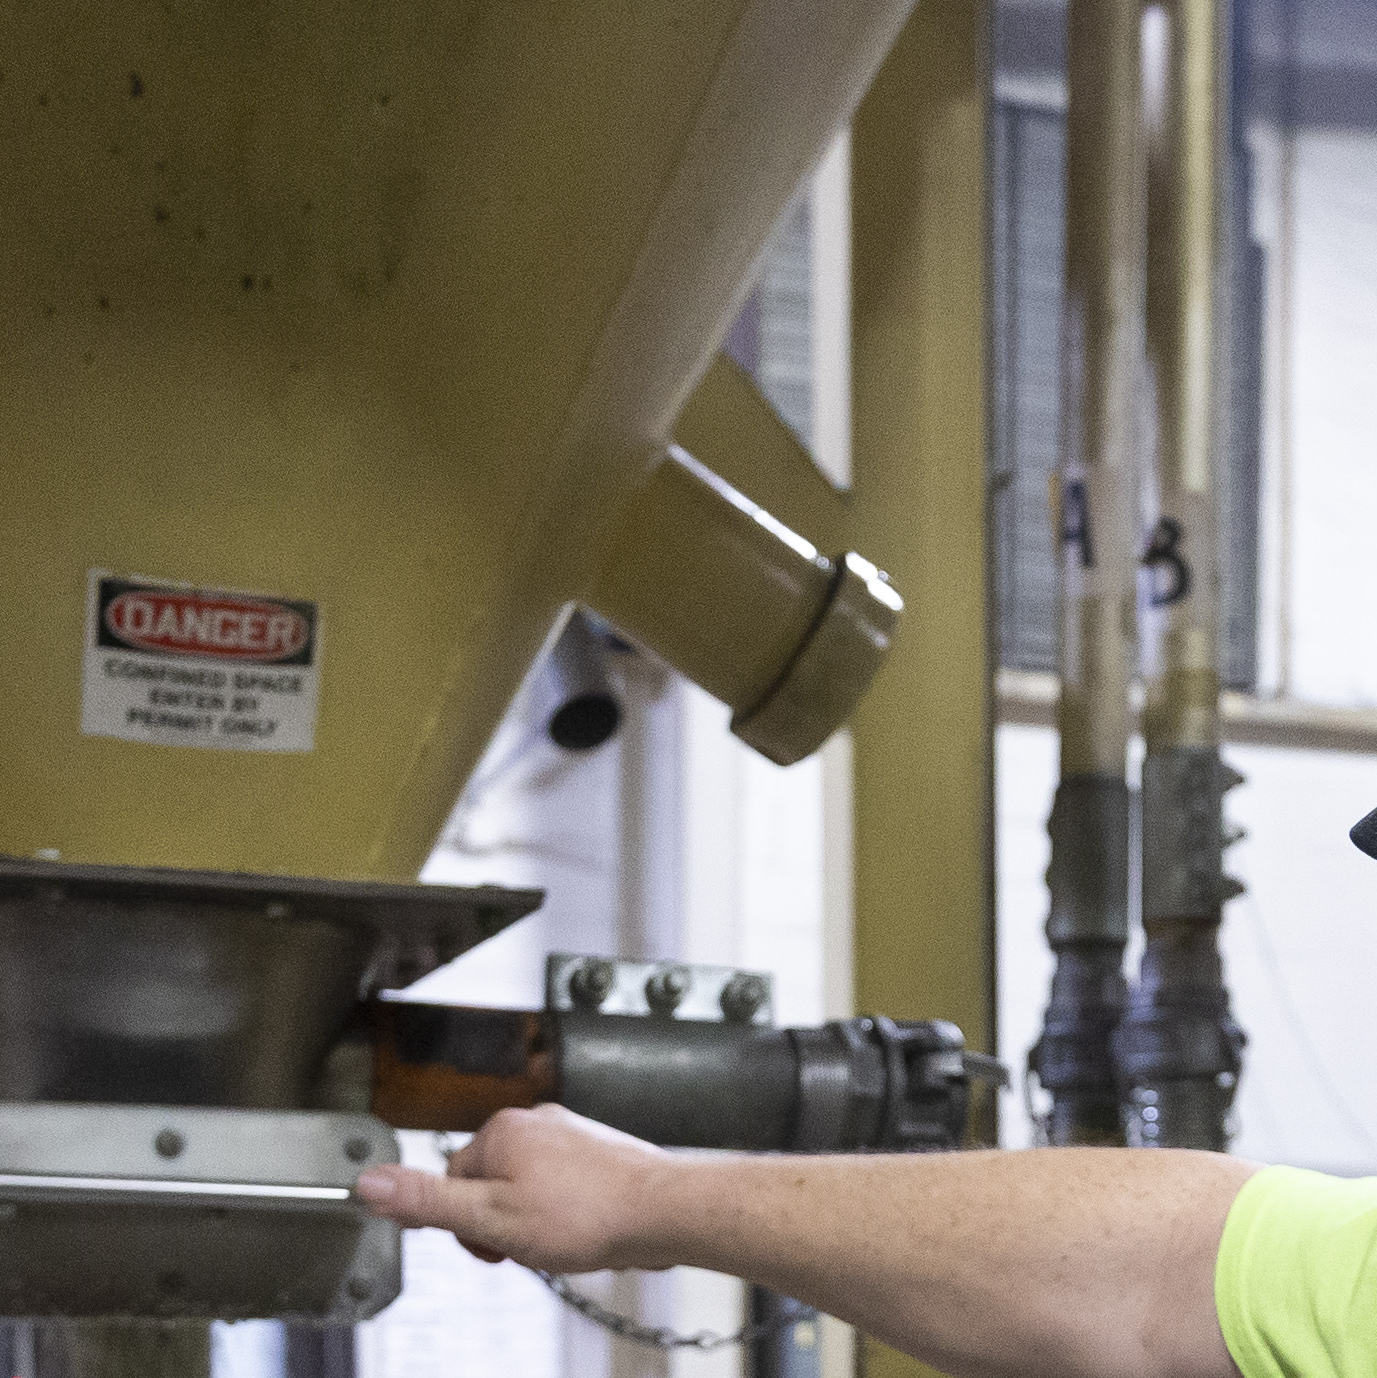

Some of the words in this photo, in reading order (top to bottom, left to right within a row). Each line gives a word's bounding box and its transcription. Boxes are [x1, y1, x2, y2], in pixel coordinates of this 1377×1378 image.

[122, 598, 294, 653] DANGER
[103, 658, 226, 689] CONFINED
[233, 673, 303, 695] SPACE
[149, 689, 224, 711] ENTER
[230, 695, 260, 713] BY
[126, 707, 213, 731] PERMIT
[221, 716, 278, 738] ONLY
